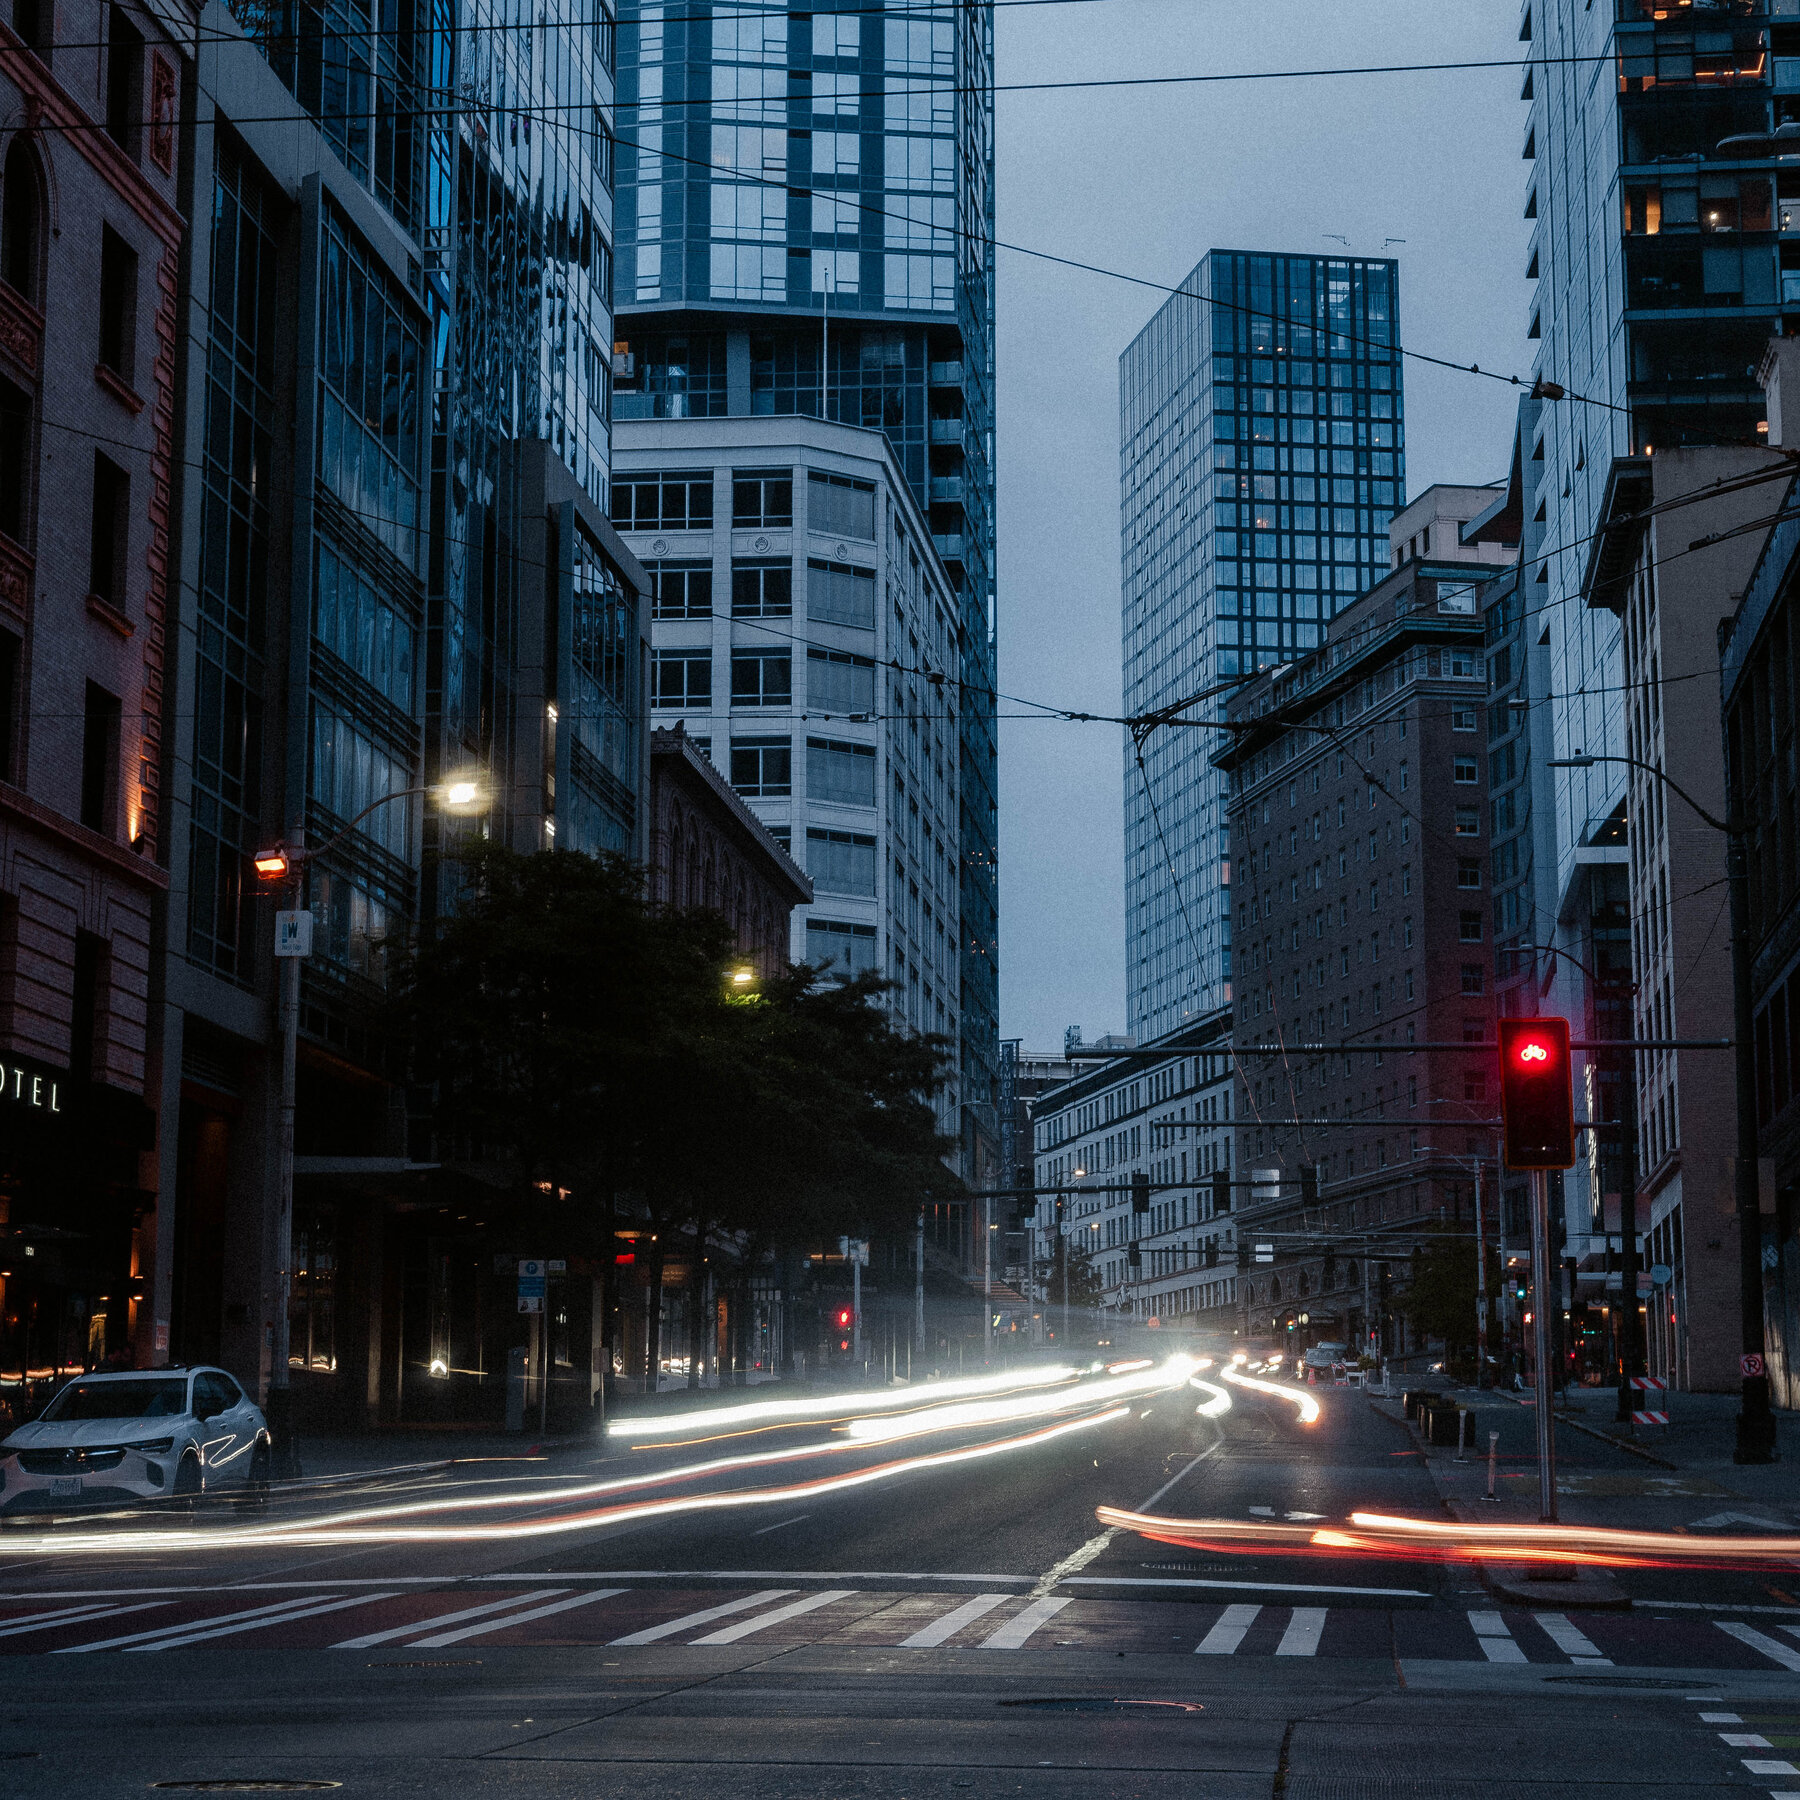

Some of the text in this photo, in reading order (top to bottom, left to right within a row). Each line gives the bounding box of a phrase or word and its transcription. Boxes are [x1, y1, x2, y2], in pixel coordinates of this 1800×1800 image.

[288, 922, 298, 938] W
[1003, 1047, 1012, 1115] PLYMOUTH
[1003, 1130, 1012, 1190] STEWART
